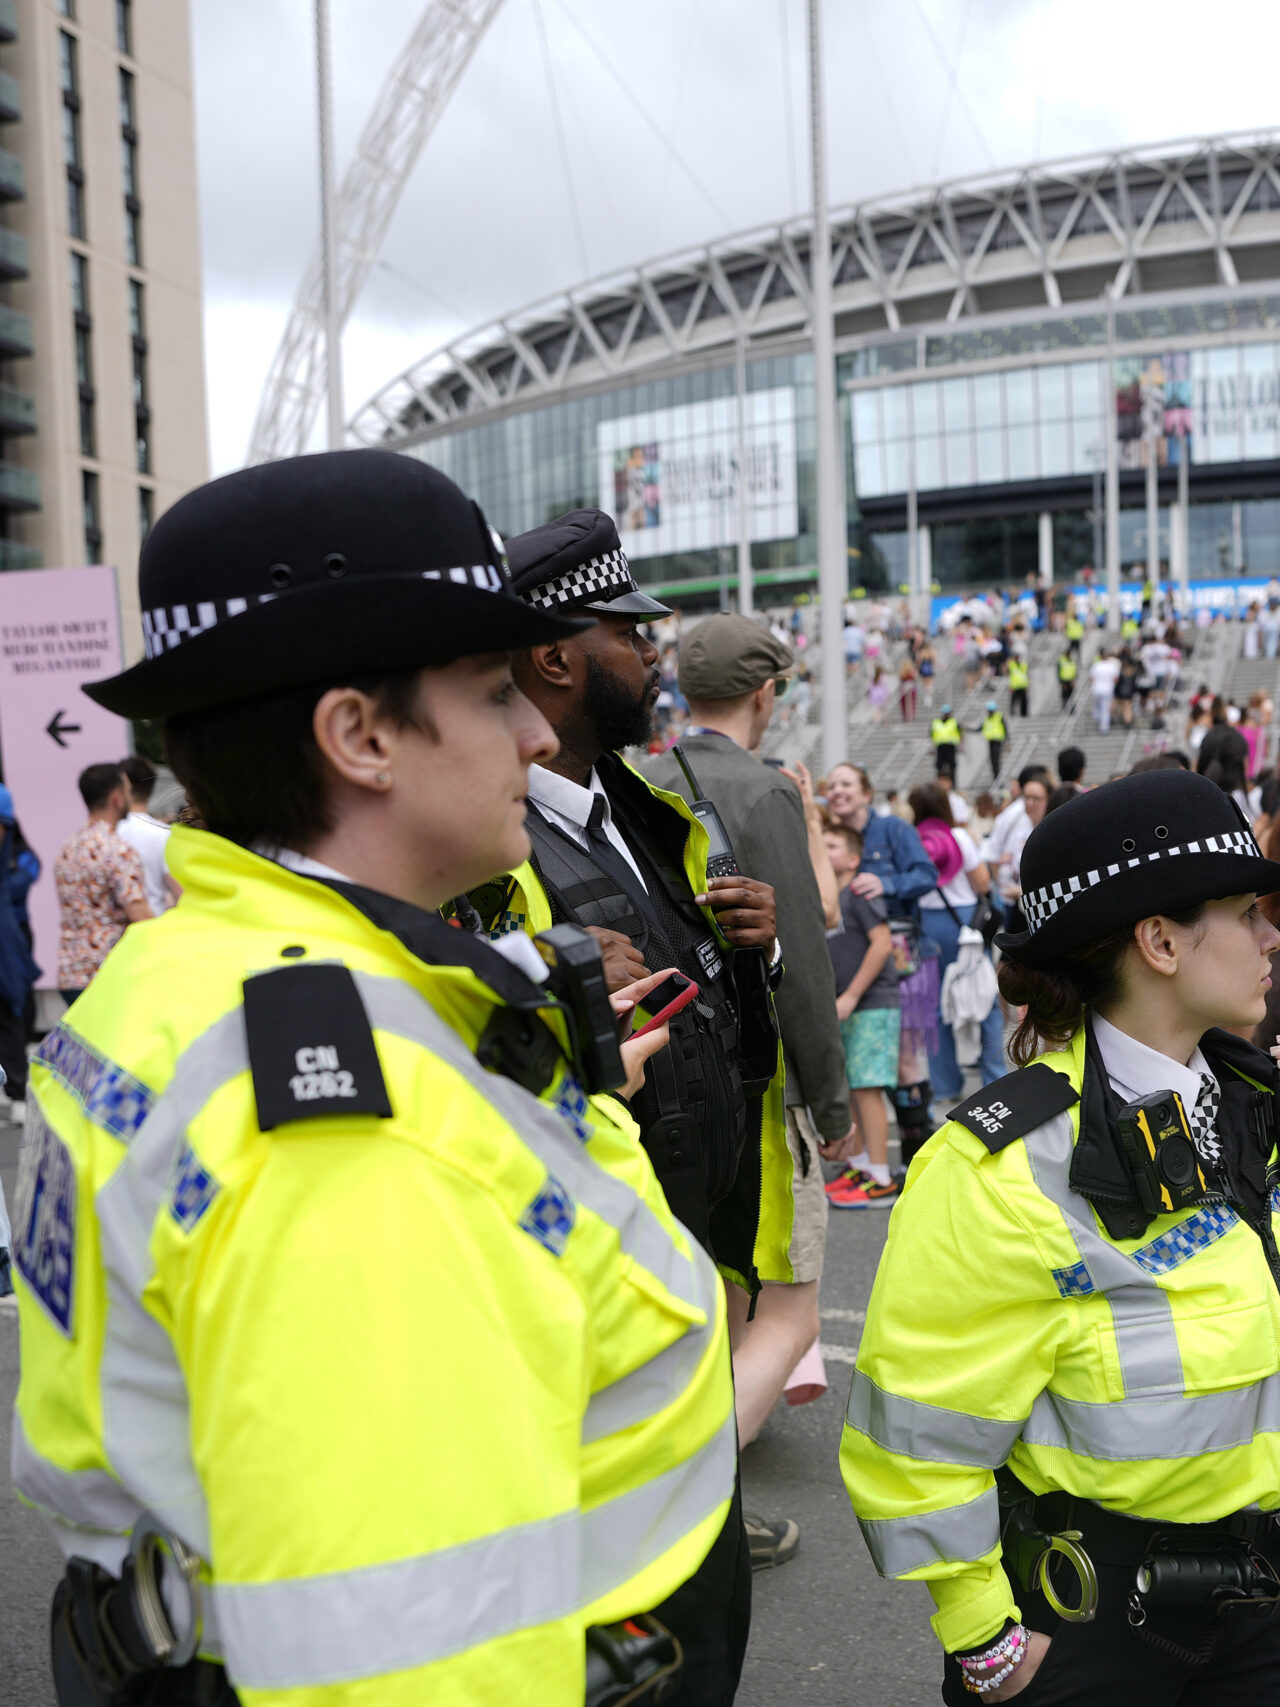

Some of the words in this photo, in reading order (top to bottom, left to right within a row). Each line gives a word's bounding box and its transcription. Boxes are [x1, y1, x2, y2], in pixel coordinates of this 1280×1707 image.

[1199, 414, 1239, 436] THE
[295, 1045, 340, 1073] CN
[967, 1106, 1004, 1134] 3445
[988, 1101, 1013, 1120] CN
